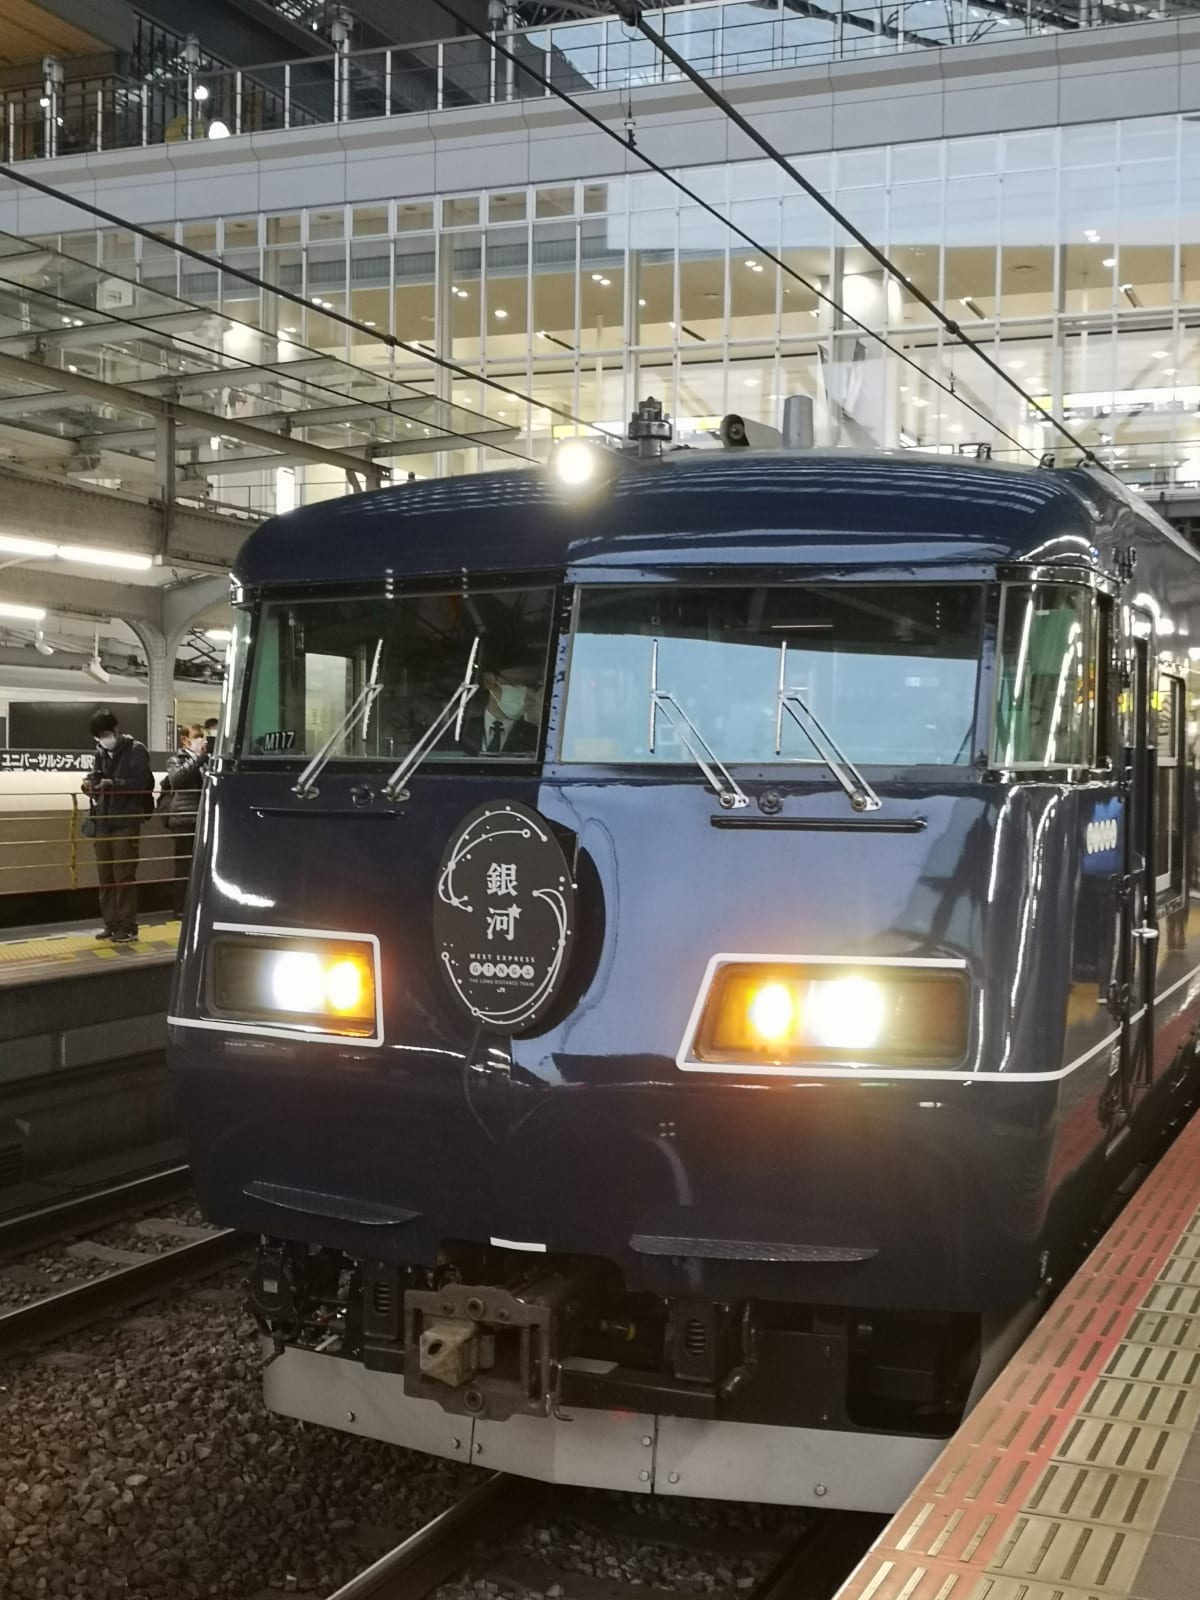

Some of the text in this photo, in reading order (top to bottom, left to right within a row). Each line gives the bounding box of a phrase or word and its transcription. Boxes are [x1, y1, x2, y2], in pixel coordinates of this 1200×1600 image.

[265, 731, 294, 750] M117
[486, 862, 522, 941] 銀河
[496, 954, 535, 963] EXPRESS
